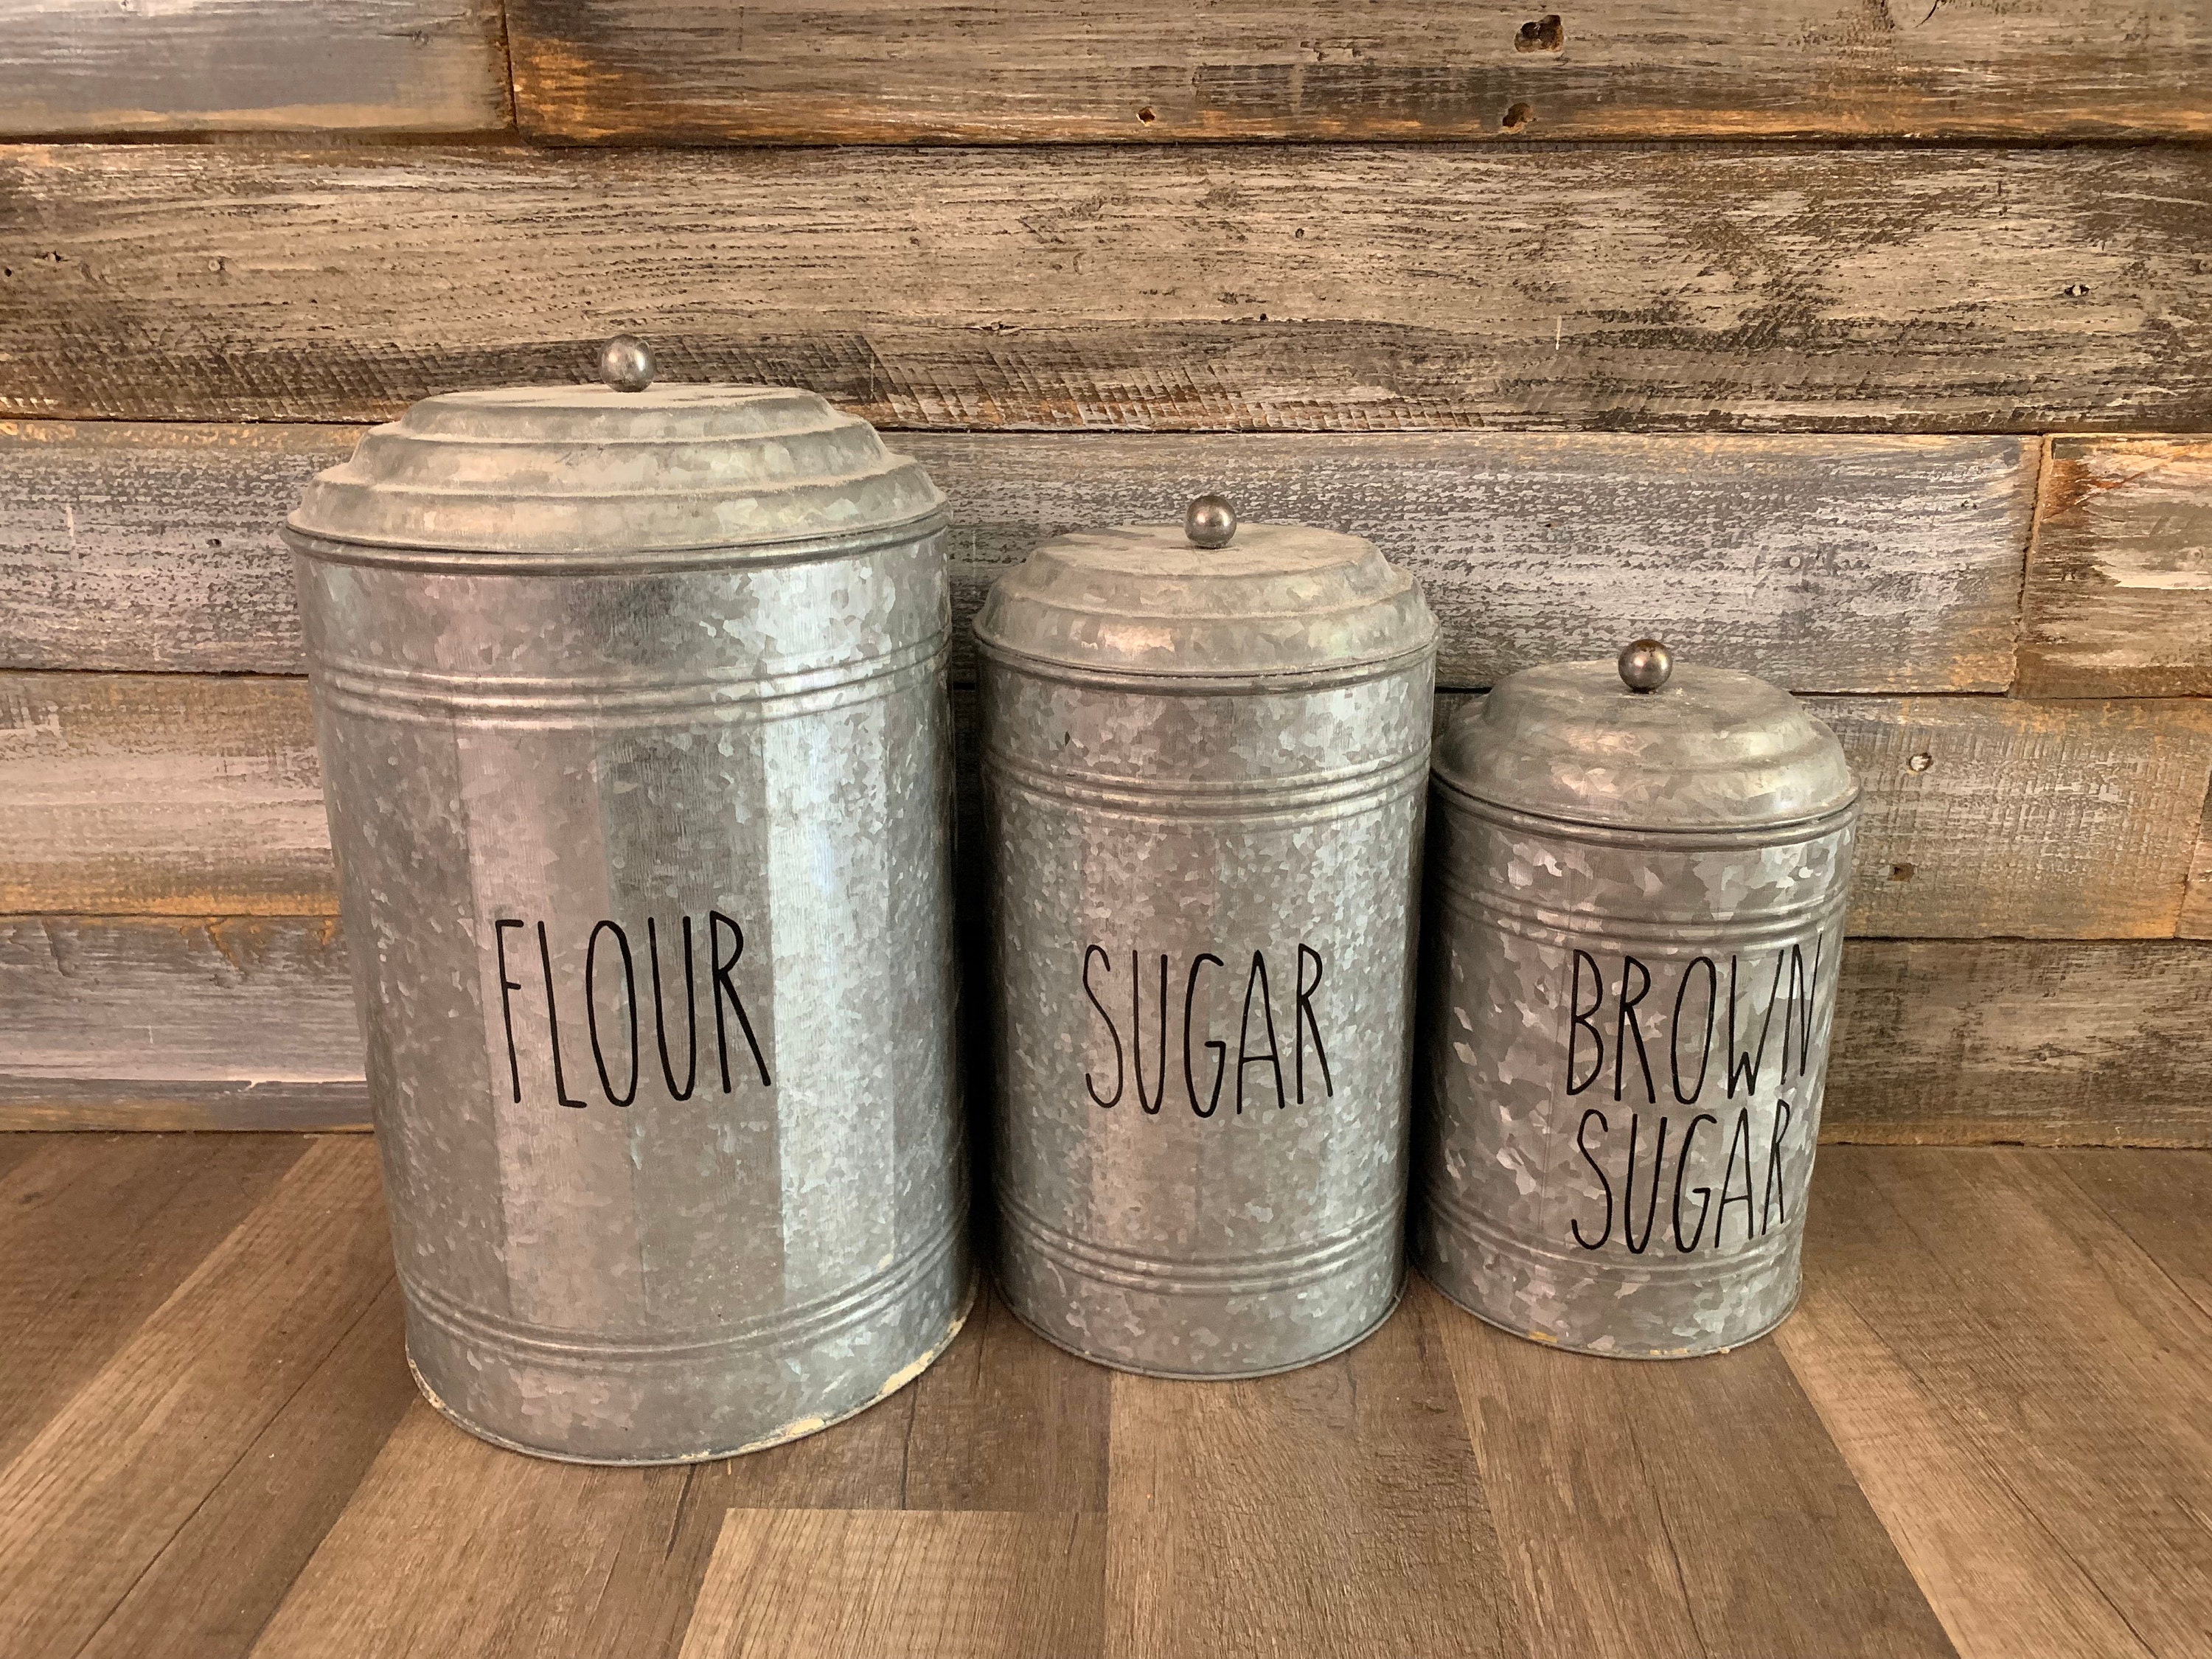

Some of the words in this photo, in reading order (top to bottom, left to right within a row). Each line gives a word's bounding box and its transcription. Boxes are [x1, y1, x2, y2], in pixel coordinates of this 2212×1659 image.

[495, 910, 771, 1108] FLOUR
[1082, 943, 1333, 1119] SUGAR
[1566, 933, 1823, 1105] BROWN
[1571, 1099, 1791, 1255] SUGAR
